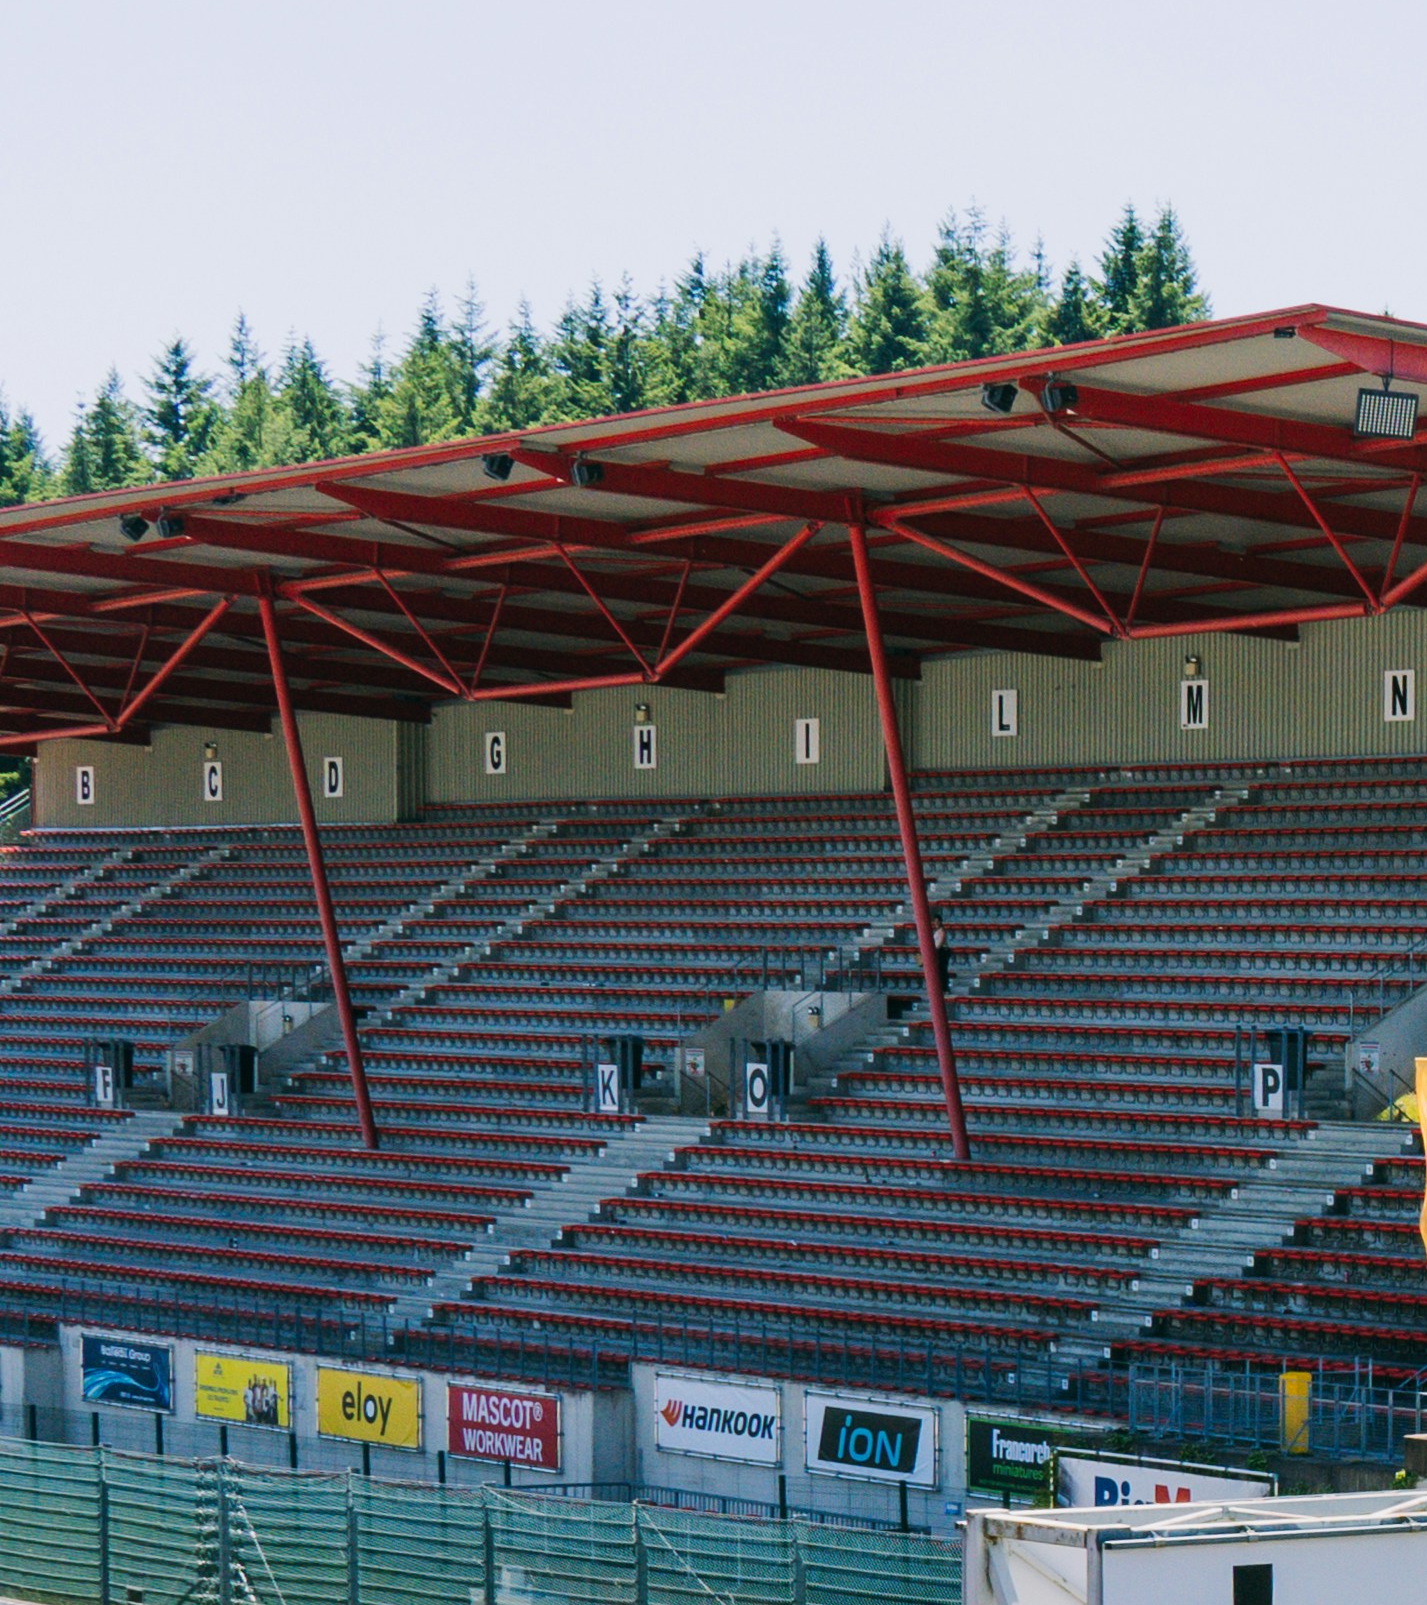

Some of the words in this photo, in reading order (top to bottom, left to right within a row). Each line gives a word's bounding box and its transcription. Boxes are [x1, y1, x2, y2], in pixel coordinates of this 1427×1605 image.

[998, 694, 1011, 732] L
[1186, 684, 1203, 725] M
[1391, 674, 1408, 717] N
[489, 735, 502, 771] G
[639, 729, 652, 765] H
[804, 722, 810, 759] I
[81, 770, 91, 800] B
[208, 765, 219, 798] C
[327, 760, 339, 794] D
[101, 1069, 111, 1099] F
[216, 1078, 226, 1109] J
[601, 1069, 616, 1106] K
[749, 1068, 767, 1108] O
[1261, 1067, 1281, 1107] P
[341, 1380, 392, 1436] eloy
[462, 1428, 543, 1462] WORKWEAR
